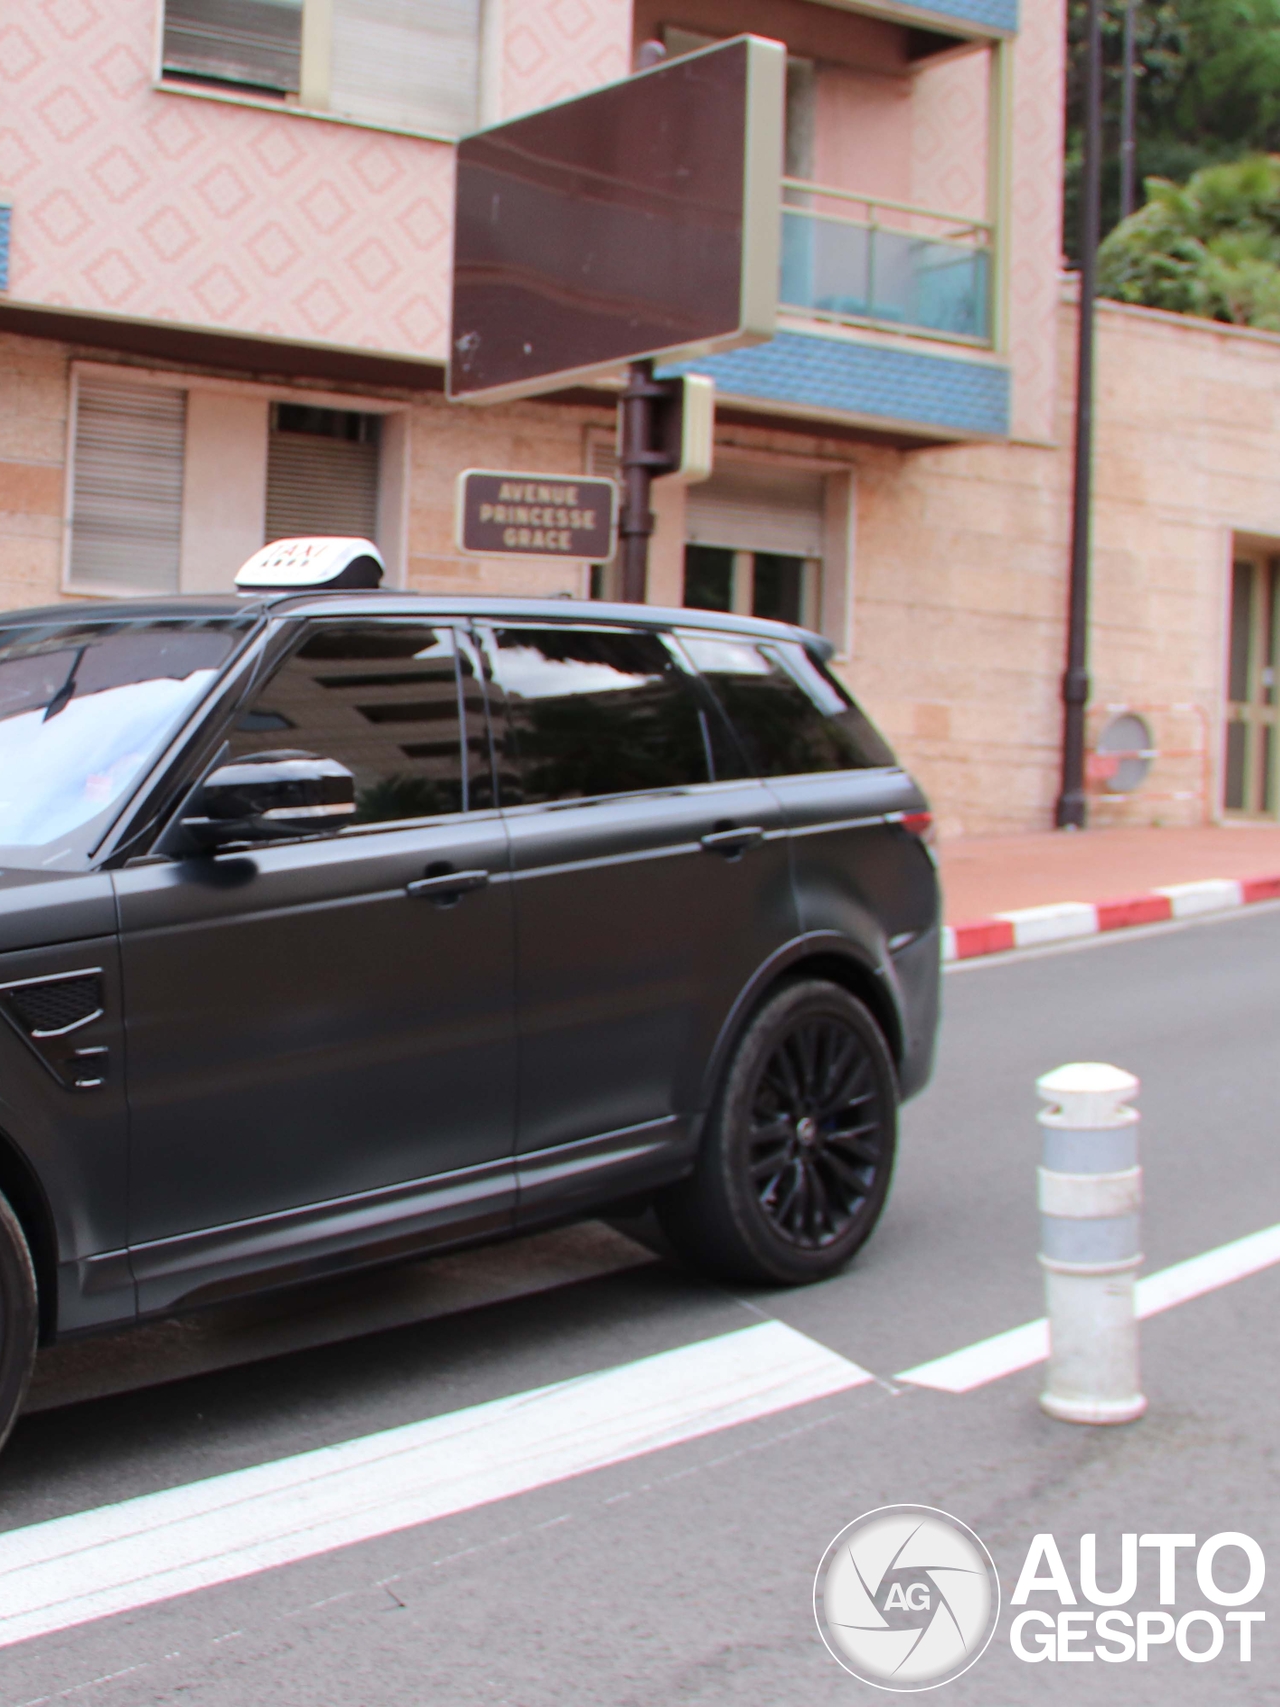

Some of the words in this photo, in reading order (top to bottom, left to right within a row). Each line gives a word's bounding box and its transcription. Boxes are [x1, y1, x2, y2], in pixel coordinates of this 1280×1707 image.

[498, 482, 579, 506] AVENUE
[479, 503, 596, 530] PRINCESSE
[503, 527, 572, 550] GRACE
